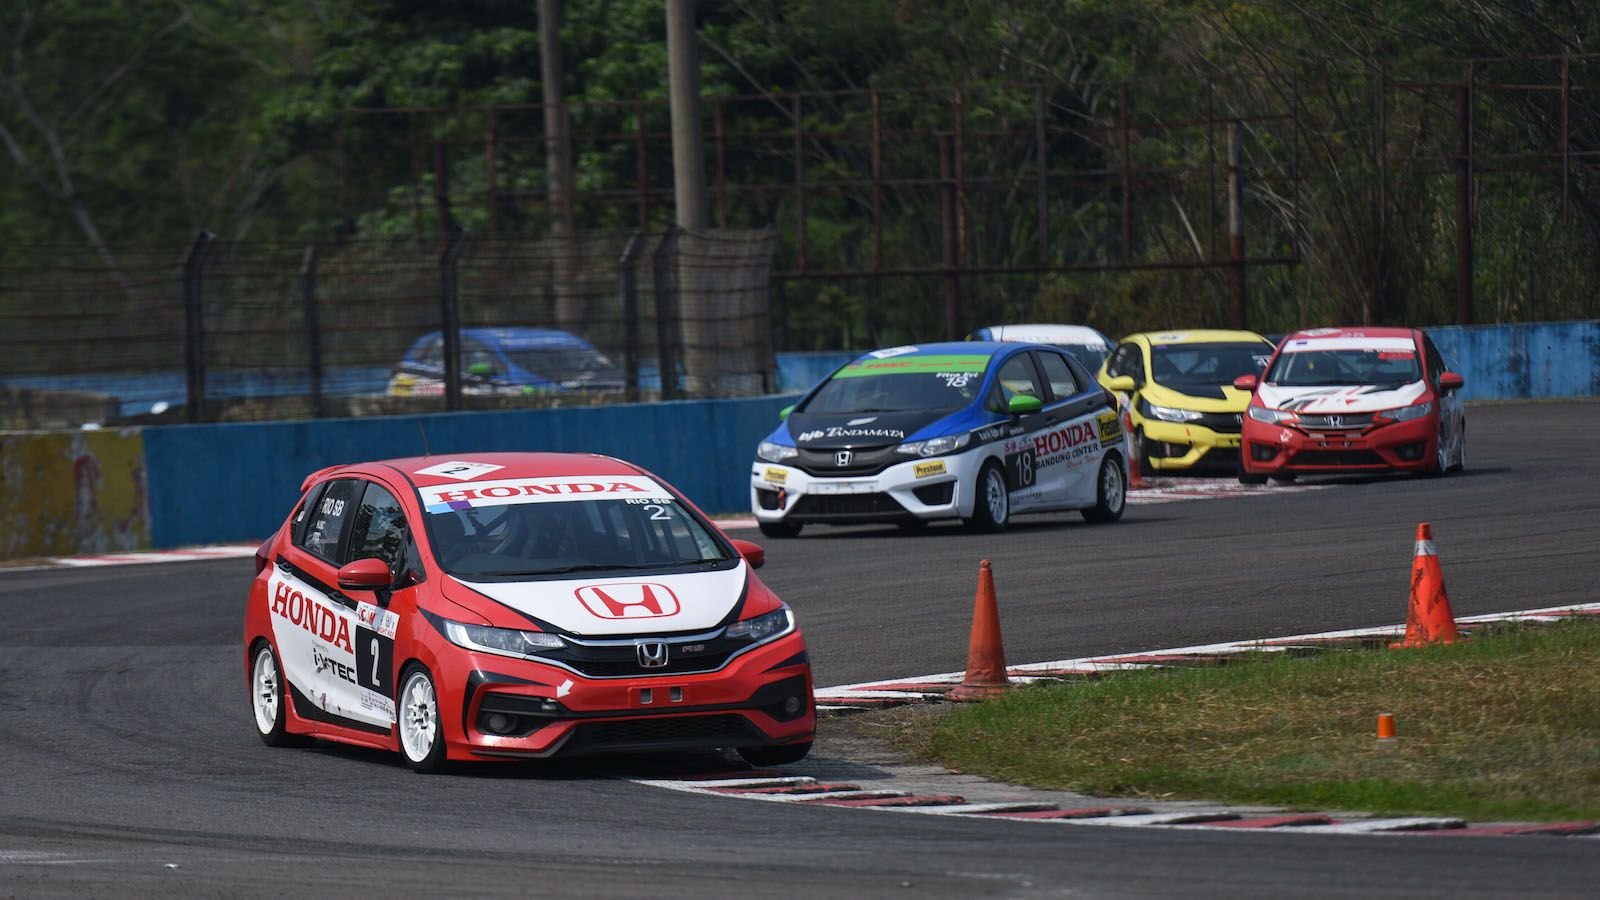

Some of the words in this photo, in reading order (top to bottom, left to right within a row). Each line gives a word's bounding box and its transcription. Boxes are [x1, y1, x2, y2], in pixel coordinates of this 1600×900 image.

[826, 427, 904, 439] TANDAMATA
[1033, 421, 1097, 458] HONDA
[1015, 452, 1032, 487] 18
[1035, 451, 1071, 470] BANDUNG
[1072, 443, 1099, 457] CENTER
[440, 466, 470, 475] 2
[433, 482, 650, 503] HONDA
[643, 504, 672, 521] 2
[271, 581, 354, 655] HONDA
[370, 637, 381, 687] 2
